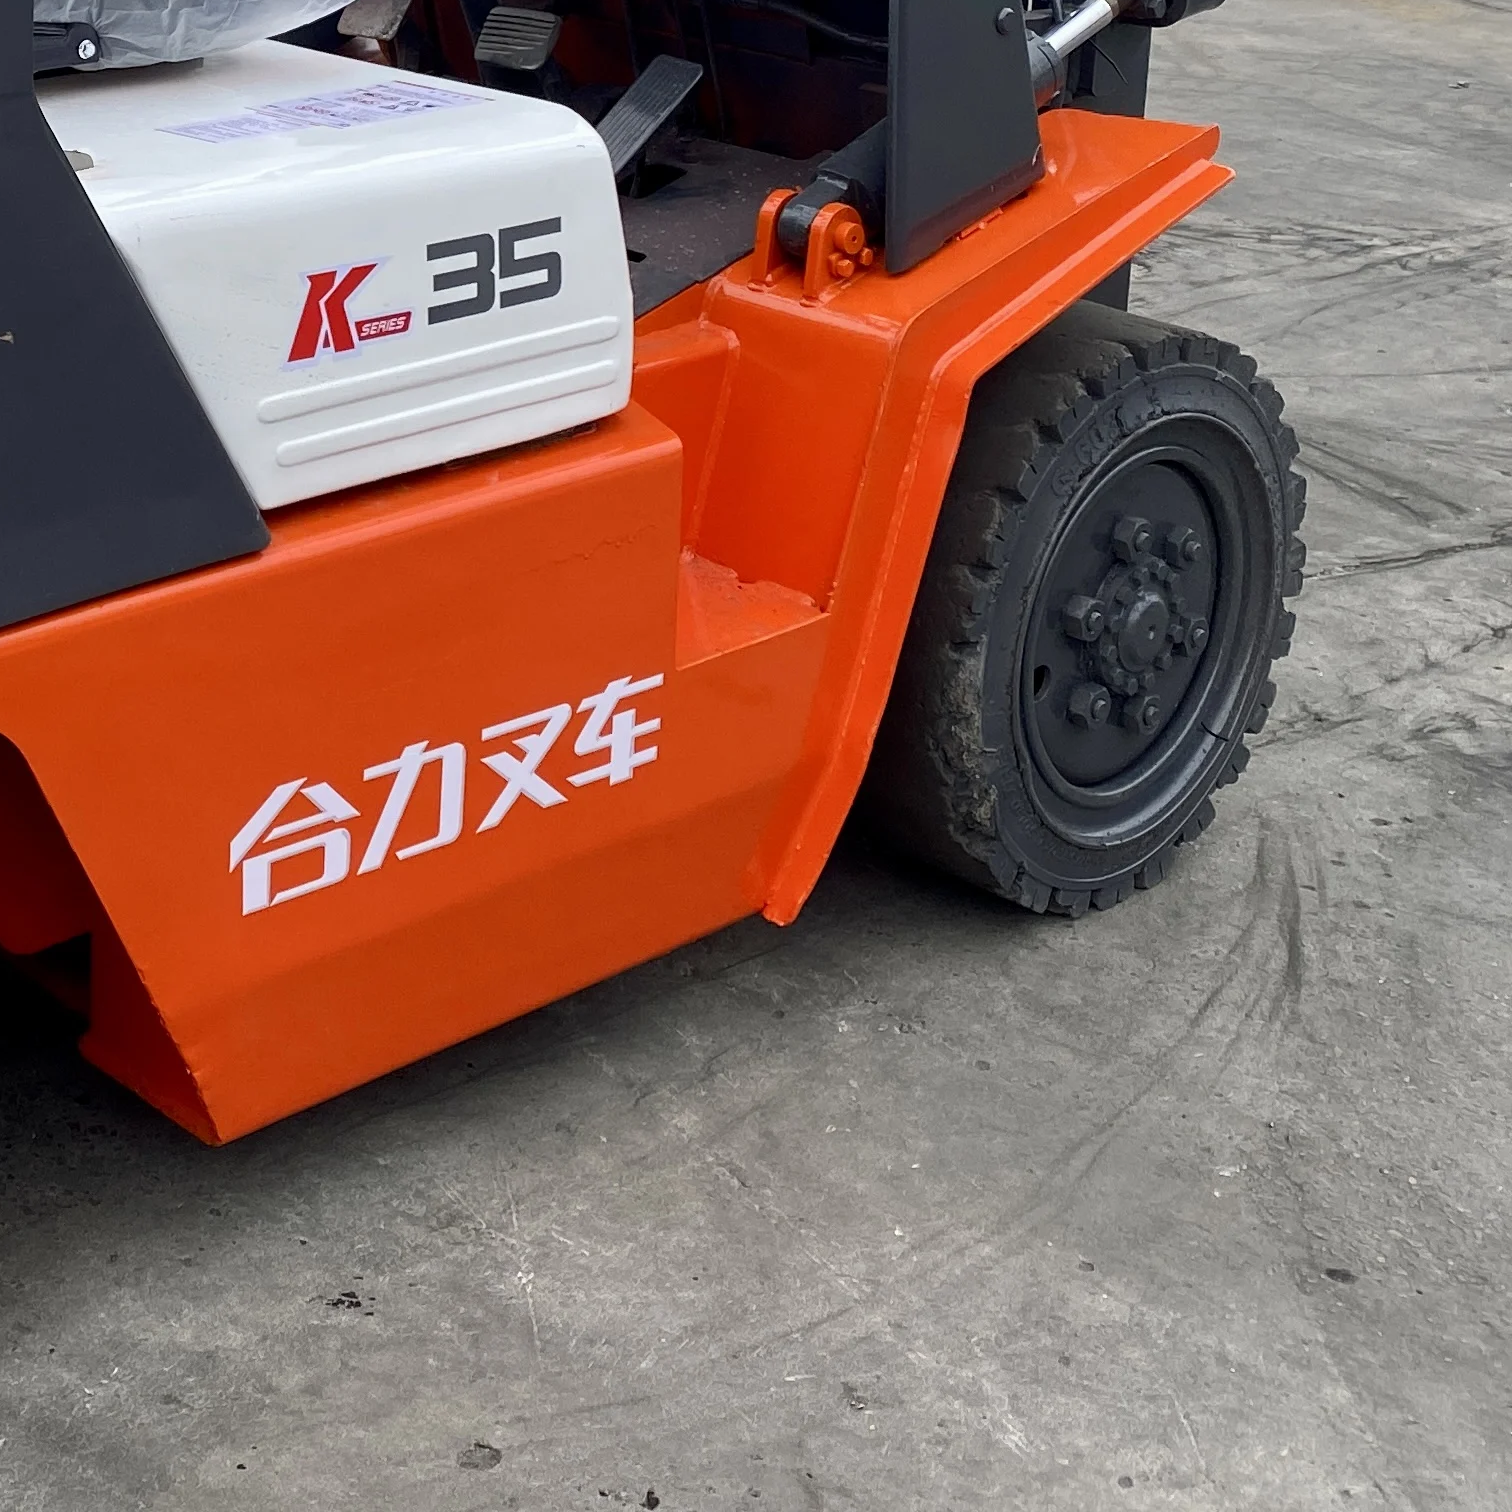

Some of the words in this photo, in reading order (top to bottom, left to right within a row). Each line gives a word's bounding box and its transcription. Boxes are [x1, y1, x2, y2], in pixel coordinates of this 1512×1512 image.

[287, 262, 379, 363] K
[426, 217, 562, 326] 35
[359, 315, 407, 338] SERIES
[228, 672, 665, 917] 合力叉车
